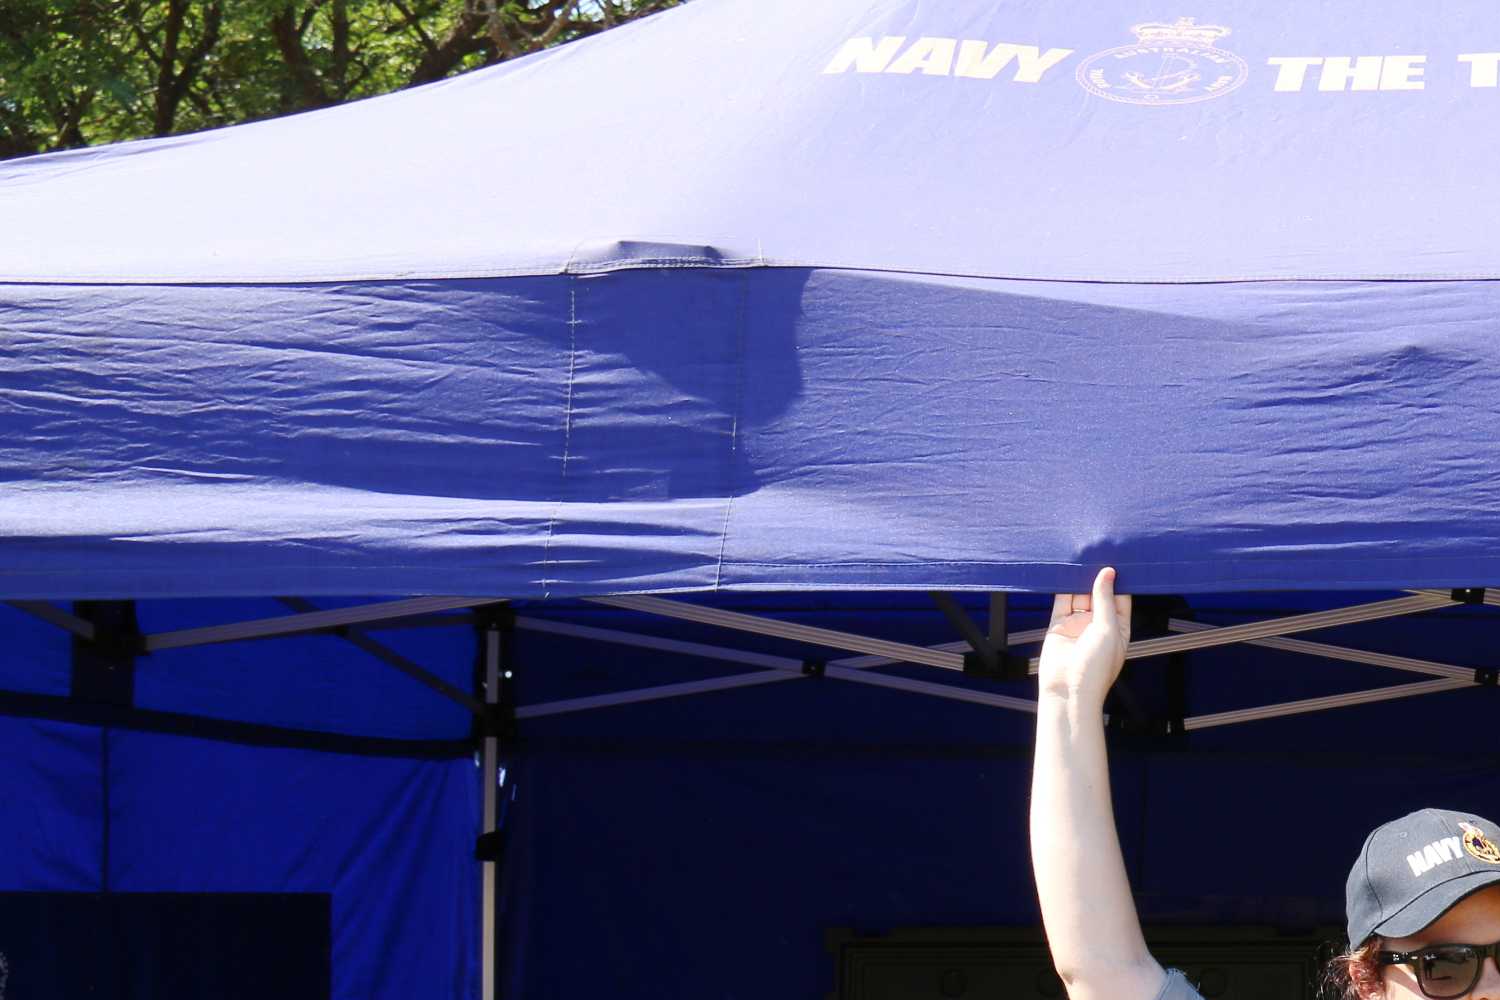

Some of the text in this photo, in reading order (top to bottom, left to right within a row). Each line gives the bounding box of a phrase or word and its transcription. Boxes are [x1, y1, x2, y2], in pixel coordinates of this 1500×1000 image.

[822, 35, 1075, 84] NAVY
[1267, 55, 1427, 92] THE
[1406, 836, 1464, 877] NAVY
